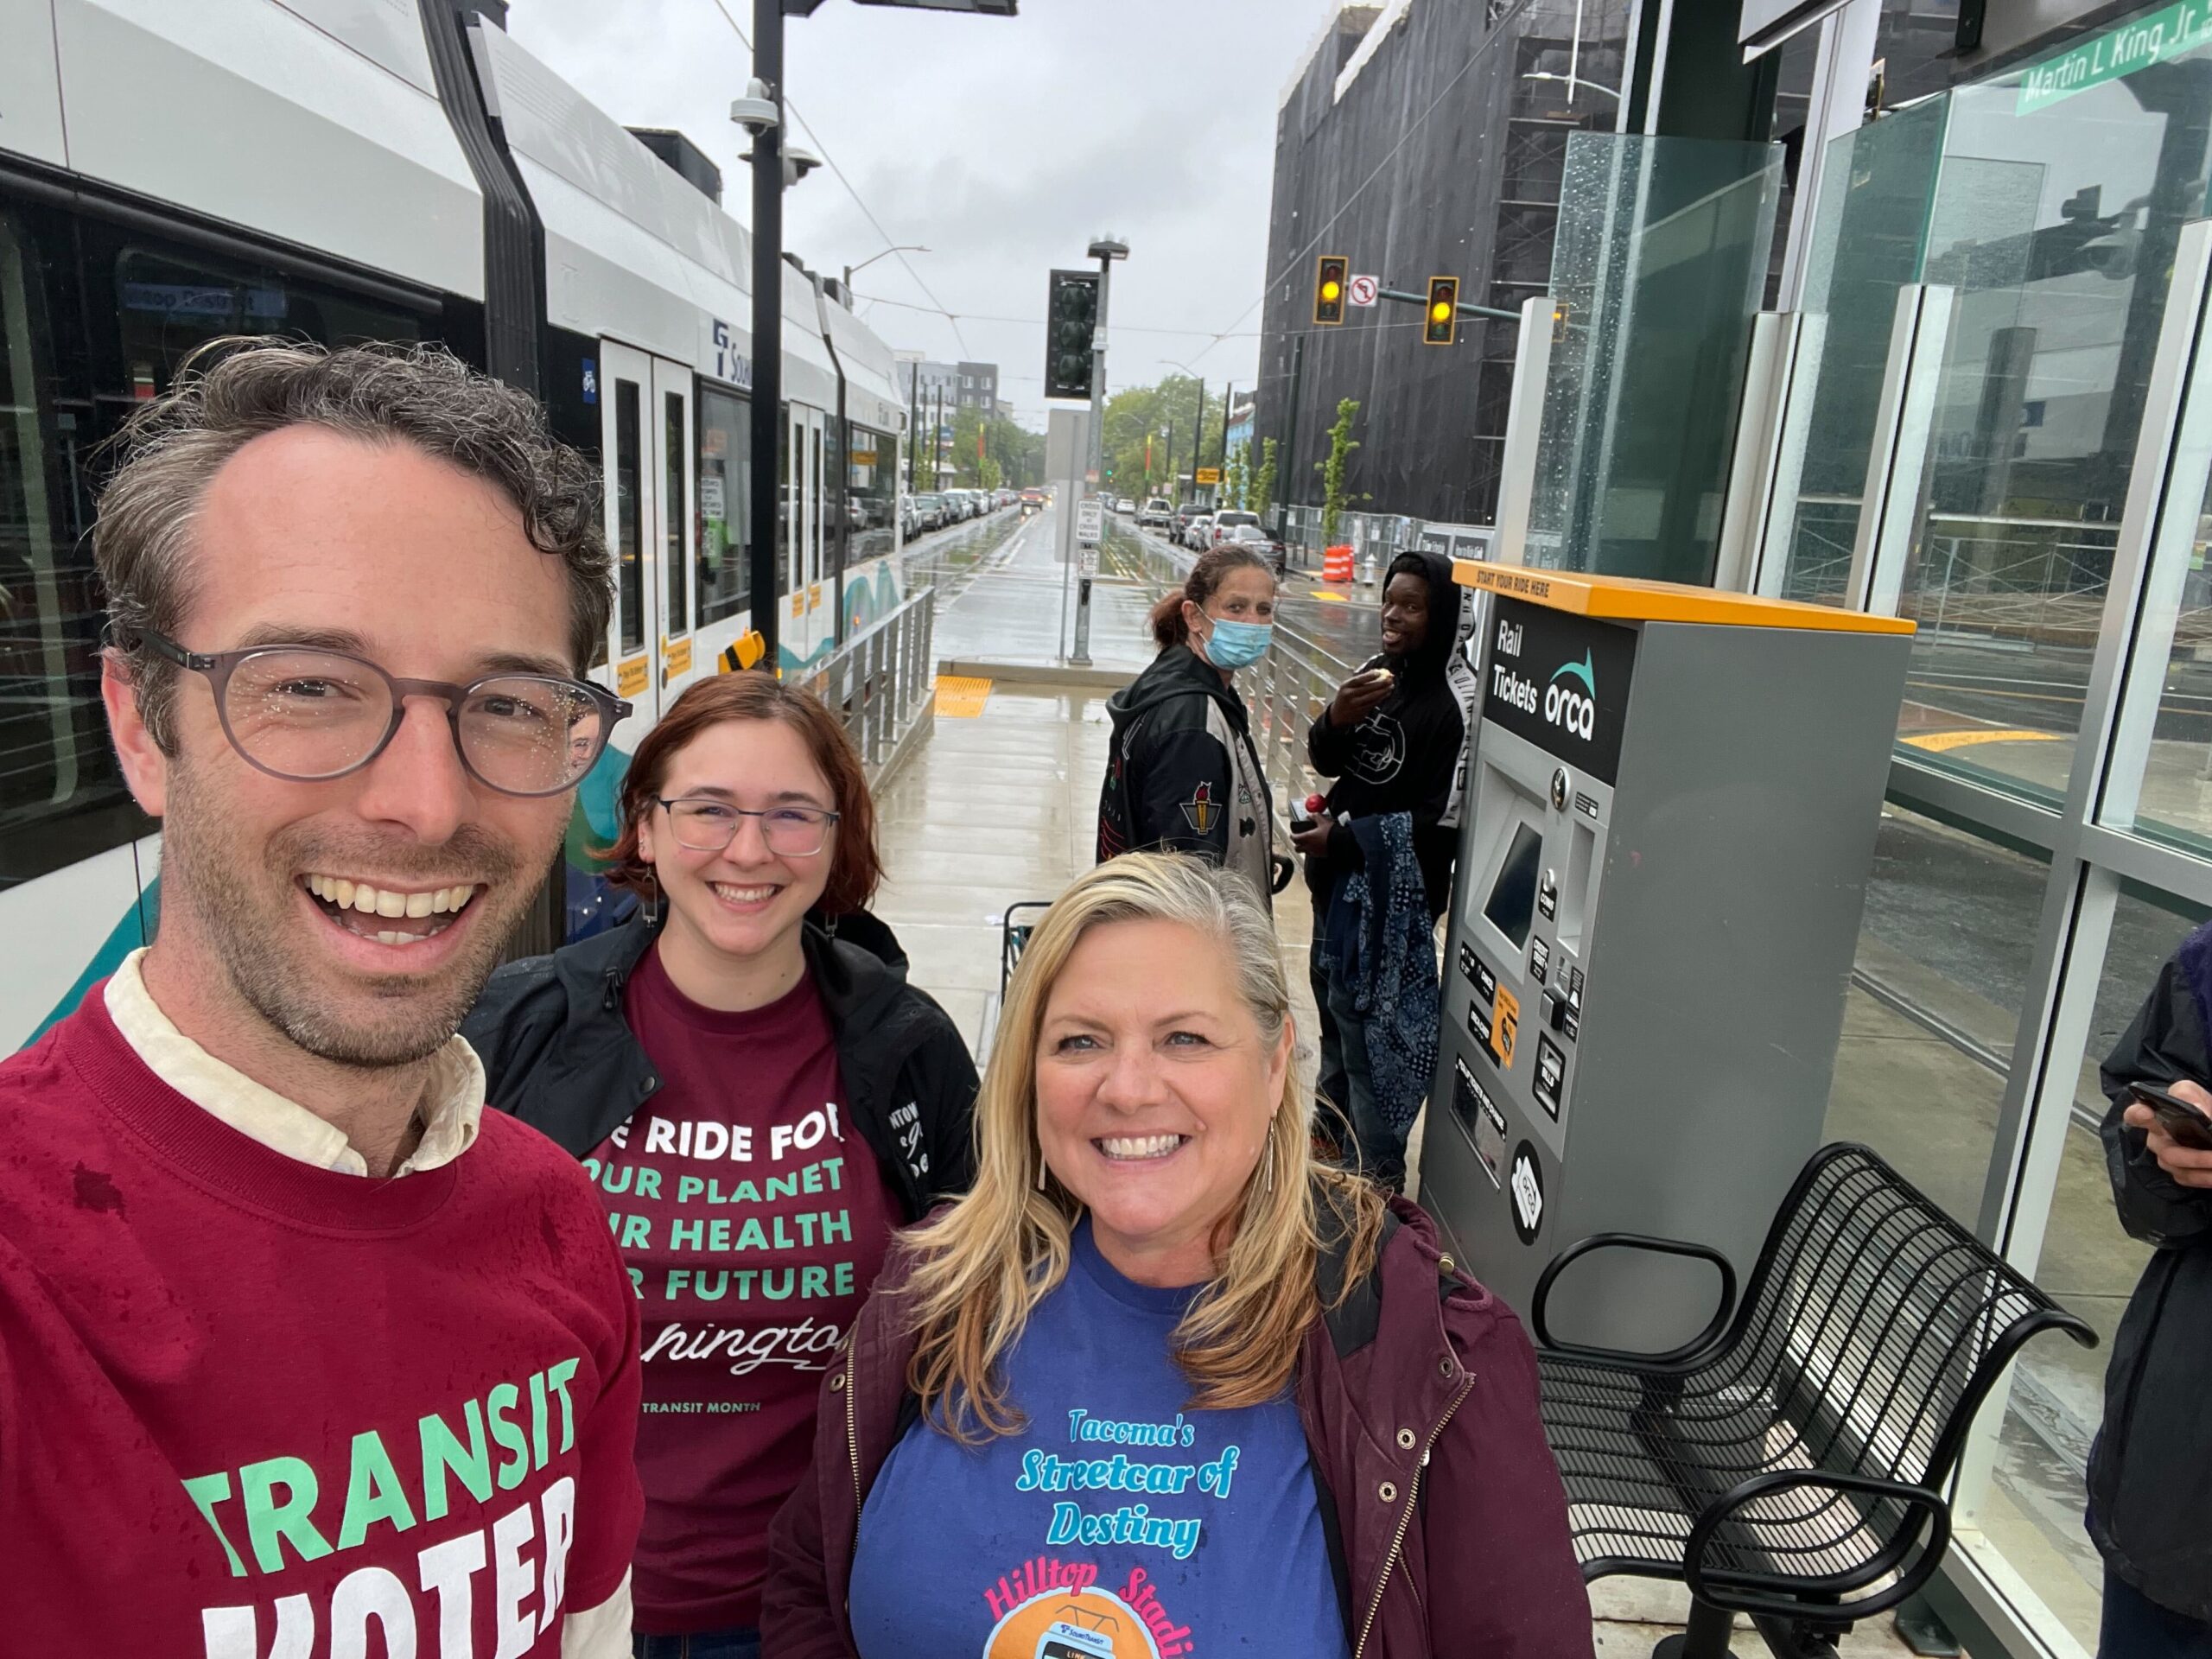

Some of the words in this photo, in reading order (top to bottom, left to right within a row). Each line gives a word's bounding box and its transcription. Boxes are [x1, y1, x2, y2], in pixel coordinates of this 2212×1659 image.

[2024, 54, 2088, 102] Martin
[2091, 41, 2104, 75] L
[2110, 22, 2164, 68] King
[2169, 4, 2196, 45] Jr
[1477, 570, 1495, 586] START
[1497, 573, 1512, 589] YOUR
[1514, 576, 1529, 594] RIDE
[1530, 580, 1550, 598] HERE
[1497, 620, 1523, 658] Rail
[1493, 664, 1538, 715] Tickets
[1545, 683, 1595, 742] orca
[645, 1116, 753, 1161] RIDE
[677, 1157, 845, 1204] PLANET
[1522, 1177, 1535, 1215] orca
[669, 1209, 853, 1251] HEALTH
[665, 1262, 855, 1301] FUTURE
[642, 1402, 702, 1414] TRANSIT
[707, 1402, 761, 1414] MONTH
[1068, 1408, 1195, 1447] Tacoma's
[180, 1357, 581, 1578] TRANSIT
[1015, 1447, 1198, 1494] Streetcar
[1198, 1445, 1241, 1499] of
[1046, 1501, 1202, 1560] Destiny
[983, 1555, 1097, 1622] Hilltop
[1119, 1566, 1194, 1659] Stadi
